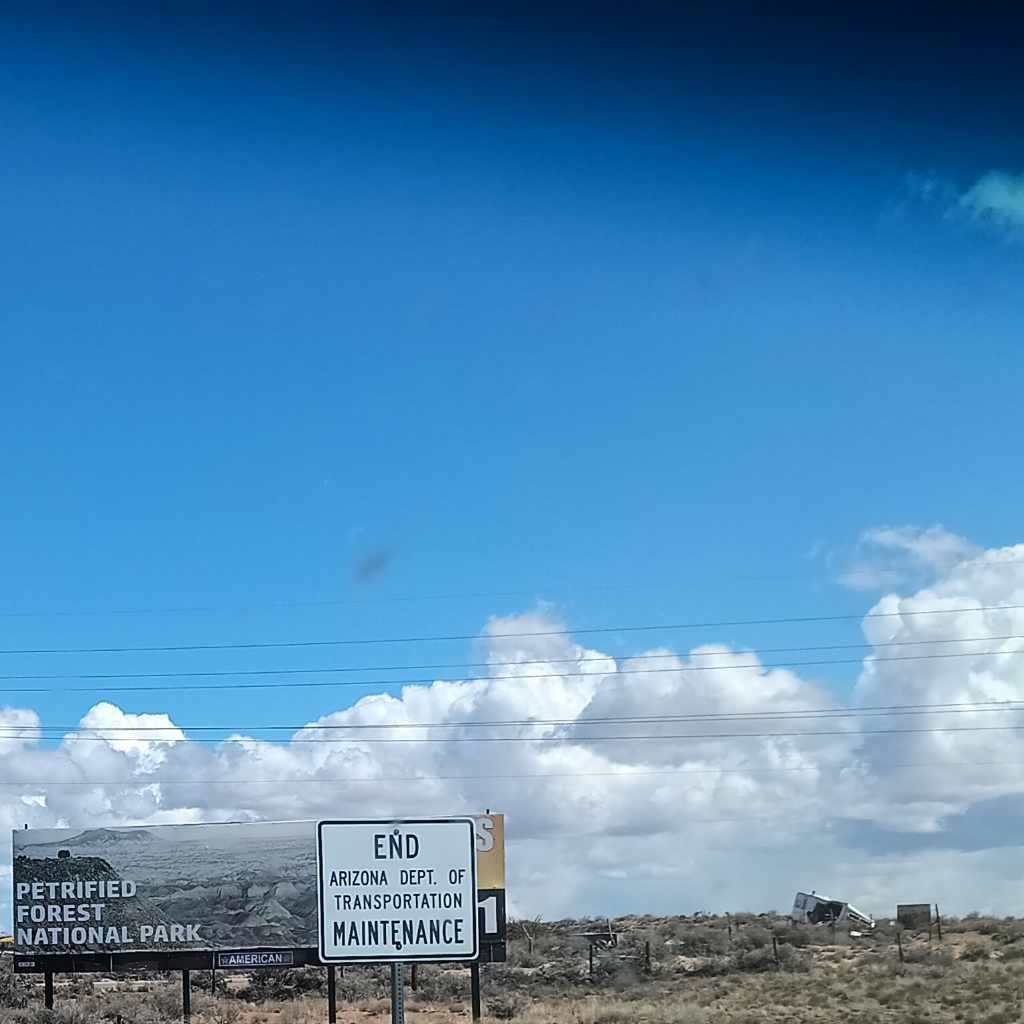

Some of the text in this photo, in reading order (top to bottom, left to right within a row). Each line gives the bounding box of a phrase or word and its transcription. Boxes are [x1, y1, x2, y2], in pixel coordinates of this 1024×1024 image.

[374, 834, 419, 859] END
[330, 869, 466, 887] ARIZONA DEPT. OF
[16, 880, 137, 900] PETRIFIED
[335, 893, 463, 910] TRANSPORTATION
[17, 903, 105, 923] FOREST
[17, 924, 202, 945] NATIONAL PARK
[333, 919, 464, 946] MAINTENANCE
[229, 953, 282, 965] AMERICAN
